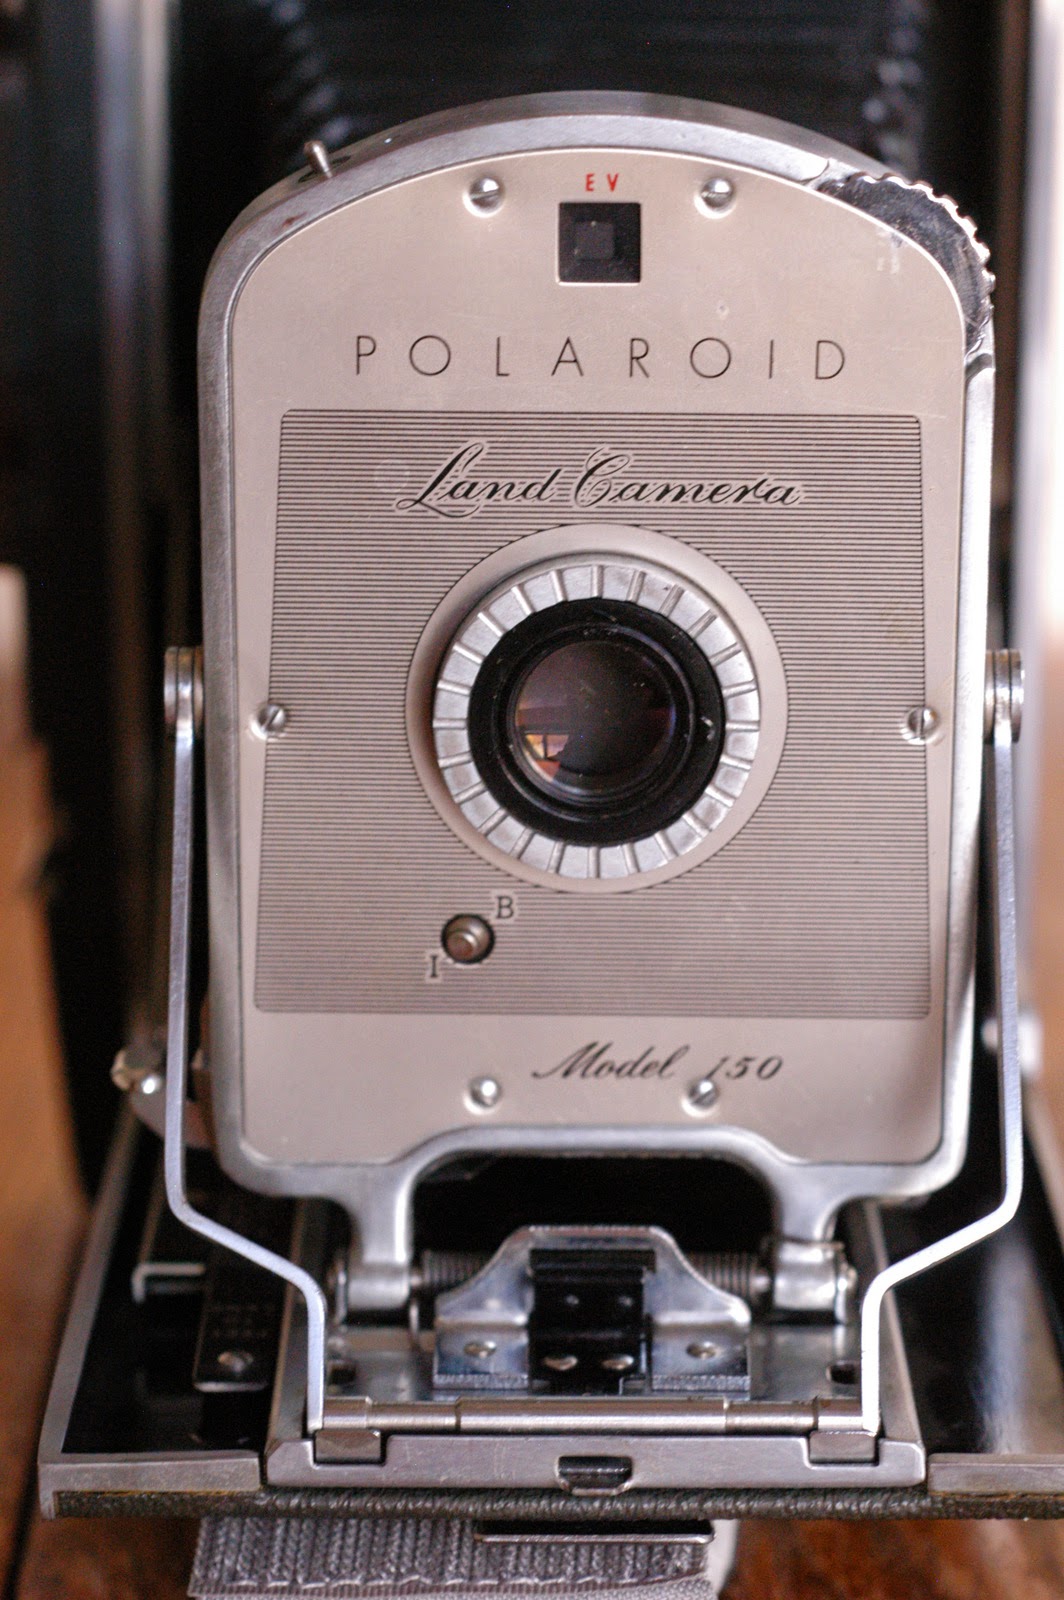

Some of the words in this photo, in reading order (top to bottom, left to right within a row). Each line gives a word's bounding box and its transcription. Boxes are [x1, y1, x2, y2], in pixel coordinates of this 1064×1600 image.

[355, 334, 846, 380] POLAROID
[396, 441, 563, 518] Land
[573, 447, 801, 507] Camera
[495, 896, 515, 920] B
[531, 1040, 691, 1080] Model
[705, 1055, 784, 1081] 150
